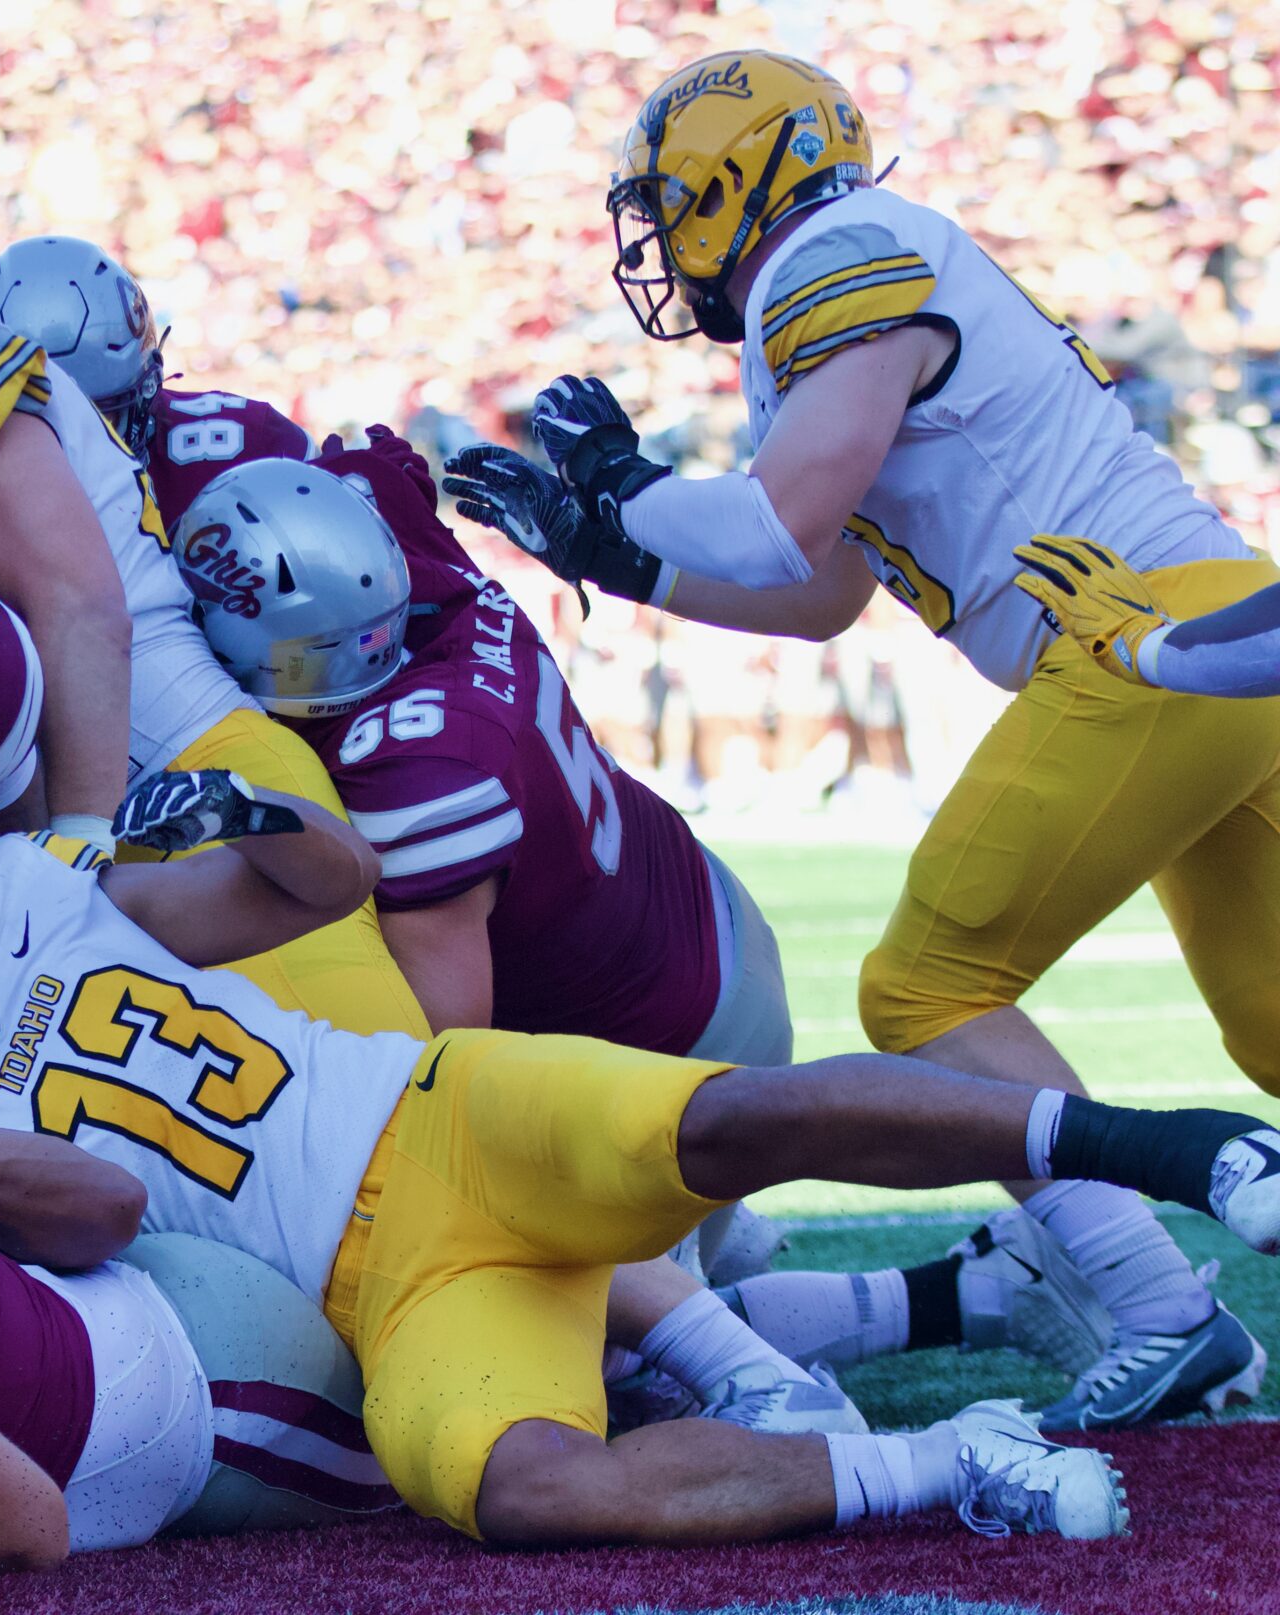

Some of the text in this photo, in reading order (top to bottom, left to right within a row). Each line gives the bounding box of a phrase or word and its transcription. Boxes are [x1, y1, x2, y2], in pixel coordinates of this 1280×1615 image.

[640, 60, 753, 132] andals
[183, 522, 266, 620] Griz
[307, 701, 358, 715] UP WITH
[30, 963, 295, 1202] 13
